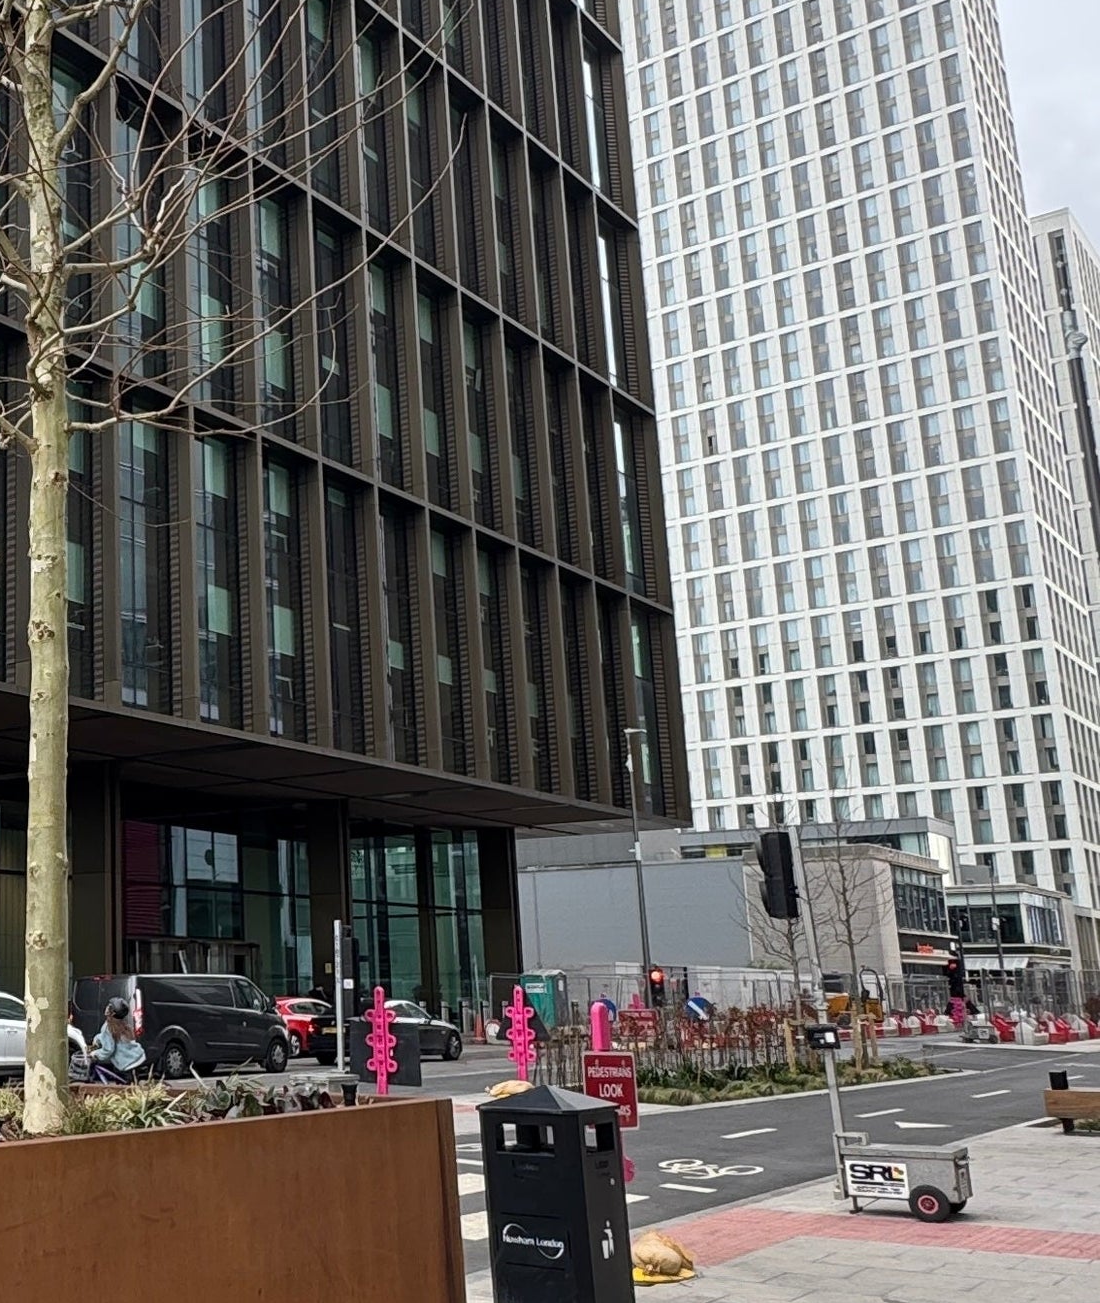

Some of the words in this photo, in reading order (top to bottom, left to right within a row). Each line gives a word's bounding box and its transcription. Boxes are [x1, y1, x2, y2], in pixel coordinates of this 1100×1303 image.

[587, 1066, 632, 1078] PEDESTRIANS
[599, 1083, 624, 1097] LOOK
[849, 1163, 904, 1183] SRL
[503, 1235, 535, 1245] Newham
[536, 1237, 564, 1248] London
